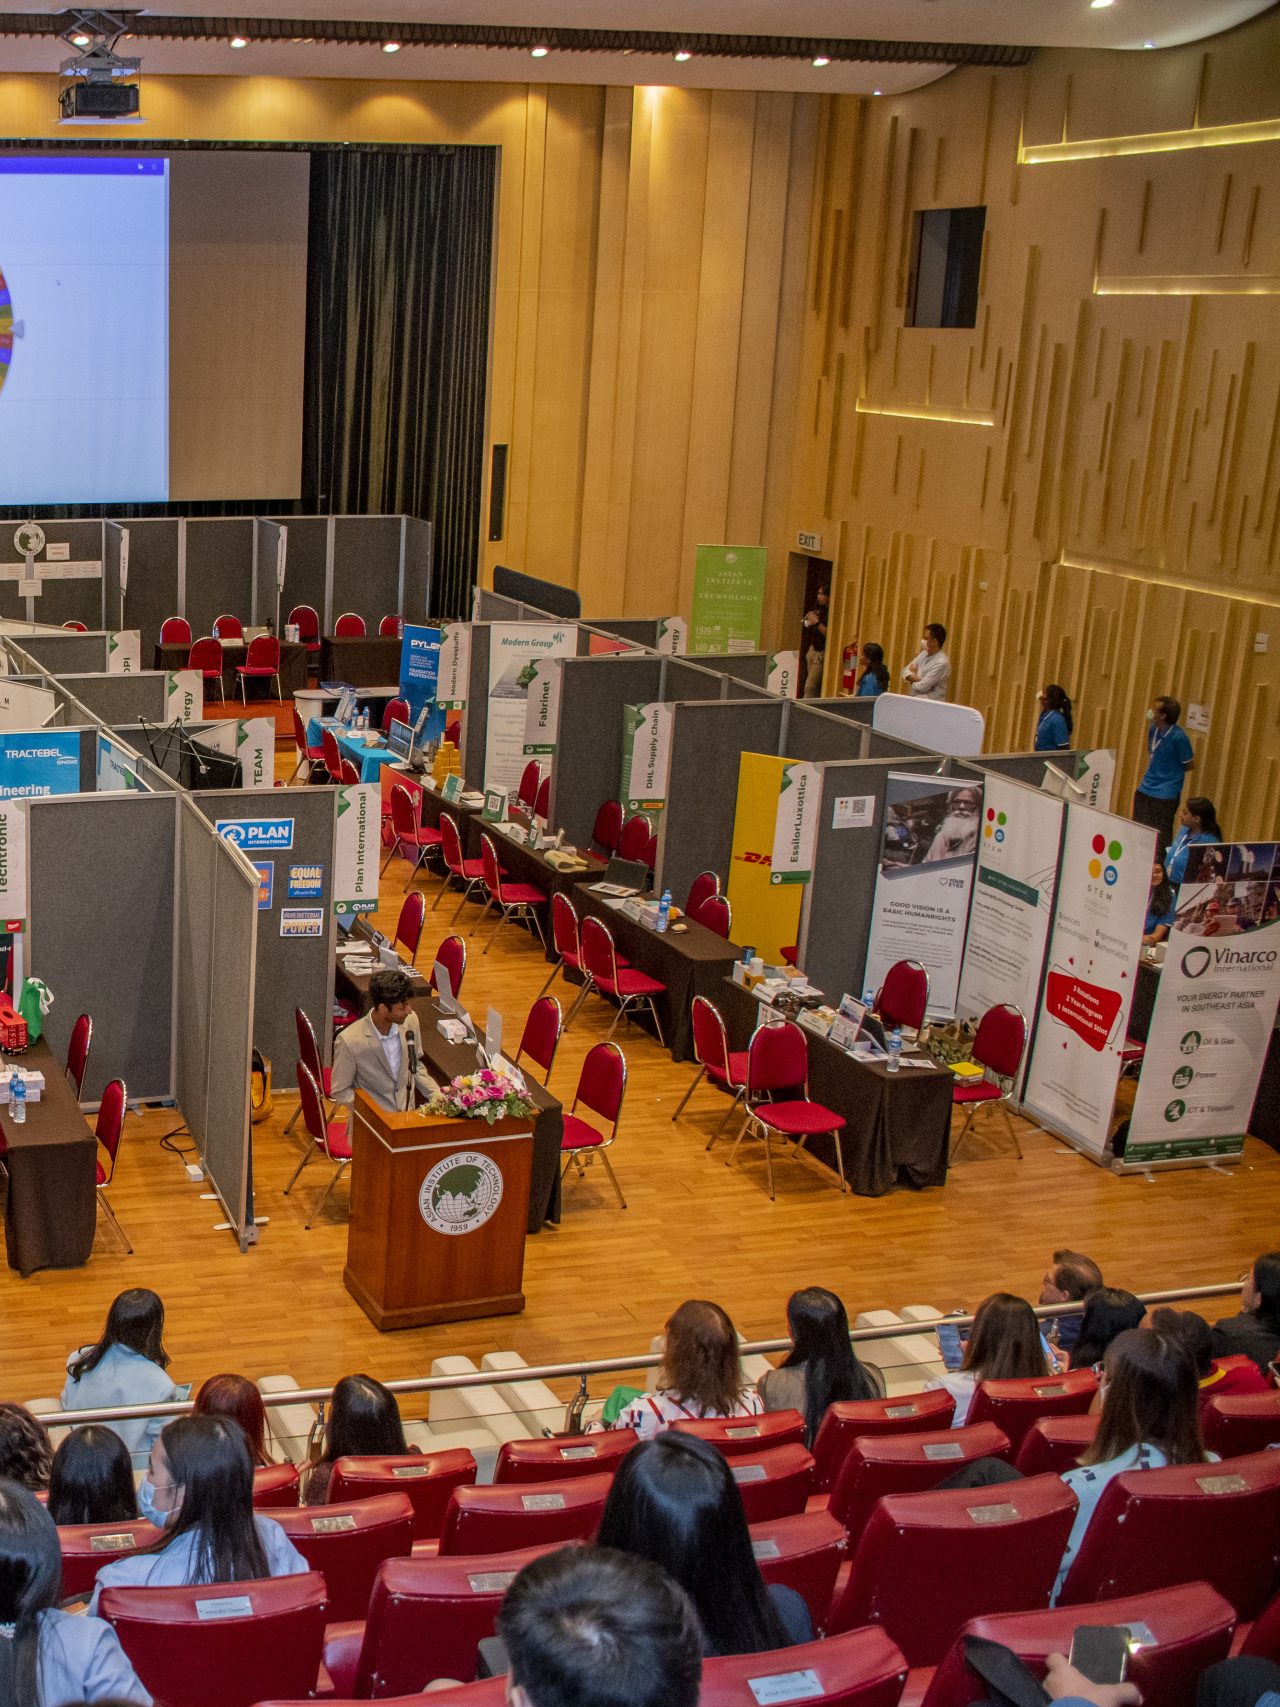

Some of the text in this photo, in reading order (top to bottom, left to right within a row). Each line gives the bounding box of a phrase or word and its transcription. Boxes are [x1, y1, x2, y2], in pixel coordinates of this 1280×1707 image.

[799, 533, 816, 548] EXIT
[699, 592, 758, 601] TECHNOLOGY
[501, 637, 554, 649] Modern Group
[450, 631, 460, 696] Modern Dyestuffs
[538, 680, 550, 728] Fabrinet
[651, 709, 659, 736] Chain
[4, 748, 62, 759] TRACTEBEL
[648, 738, 658, 772] Supply
[253, 748, 263, 785] TEAM
[790, 774, 807, 863] EssilorLuxottica
[247, 826, 289, 839] PLAN
[354, 792, 367, 893] Plan International
[743, 852, 772, 866] DH
[290, 867, 321, 880] EQUAL
[289, 880, 321, 889] FREEDOM
[1087, 884, 1113, 902] STEM
[889, 901, 911, 909] GOOD
[911, 903, 936, 913] VISION
[882, 907, 956, 923] BASIC HUMANRIGHTS
[283, 921, 319, 934] POWER
[1095, 929, 1128, 950] Engineering
[1213, 948, 1277, 964] Vinarco
[1213, 963, 1273, 974] International
[1176, 990, 1265, 1003] YOUR ENERGY PARTNER
[1181, 1001, 1255, 1013] IN SOUTHEAST ASIA
[1202, 1037, 1212, 1045] Oil
[1219, 1037, 1235, 1045] Gas
[1194, 1071, 1217, 1079] Power
[1186, 1105, 1198, 1114] ICT
[1206, 1104, 1235, 1113] Telecom
[423, 1155, 501, 1224] ASIAN INSTITUTE OF TECHNOLOGY
[449, 1222, 469, 1233] 1959
